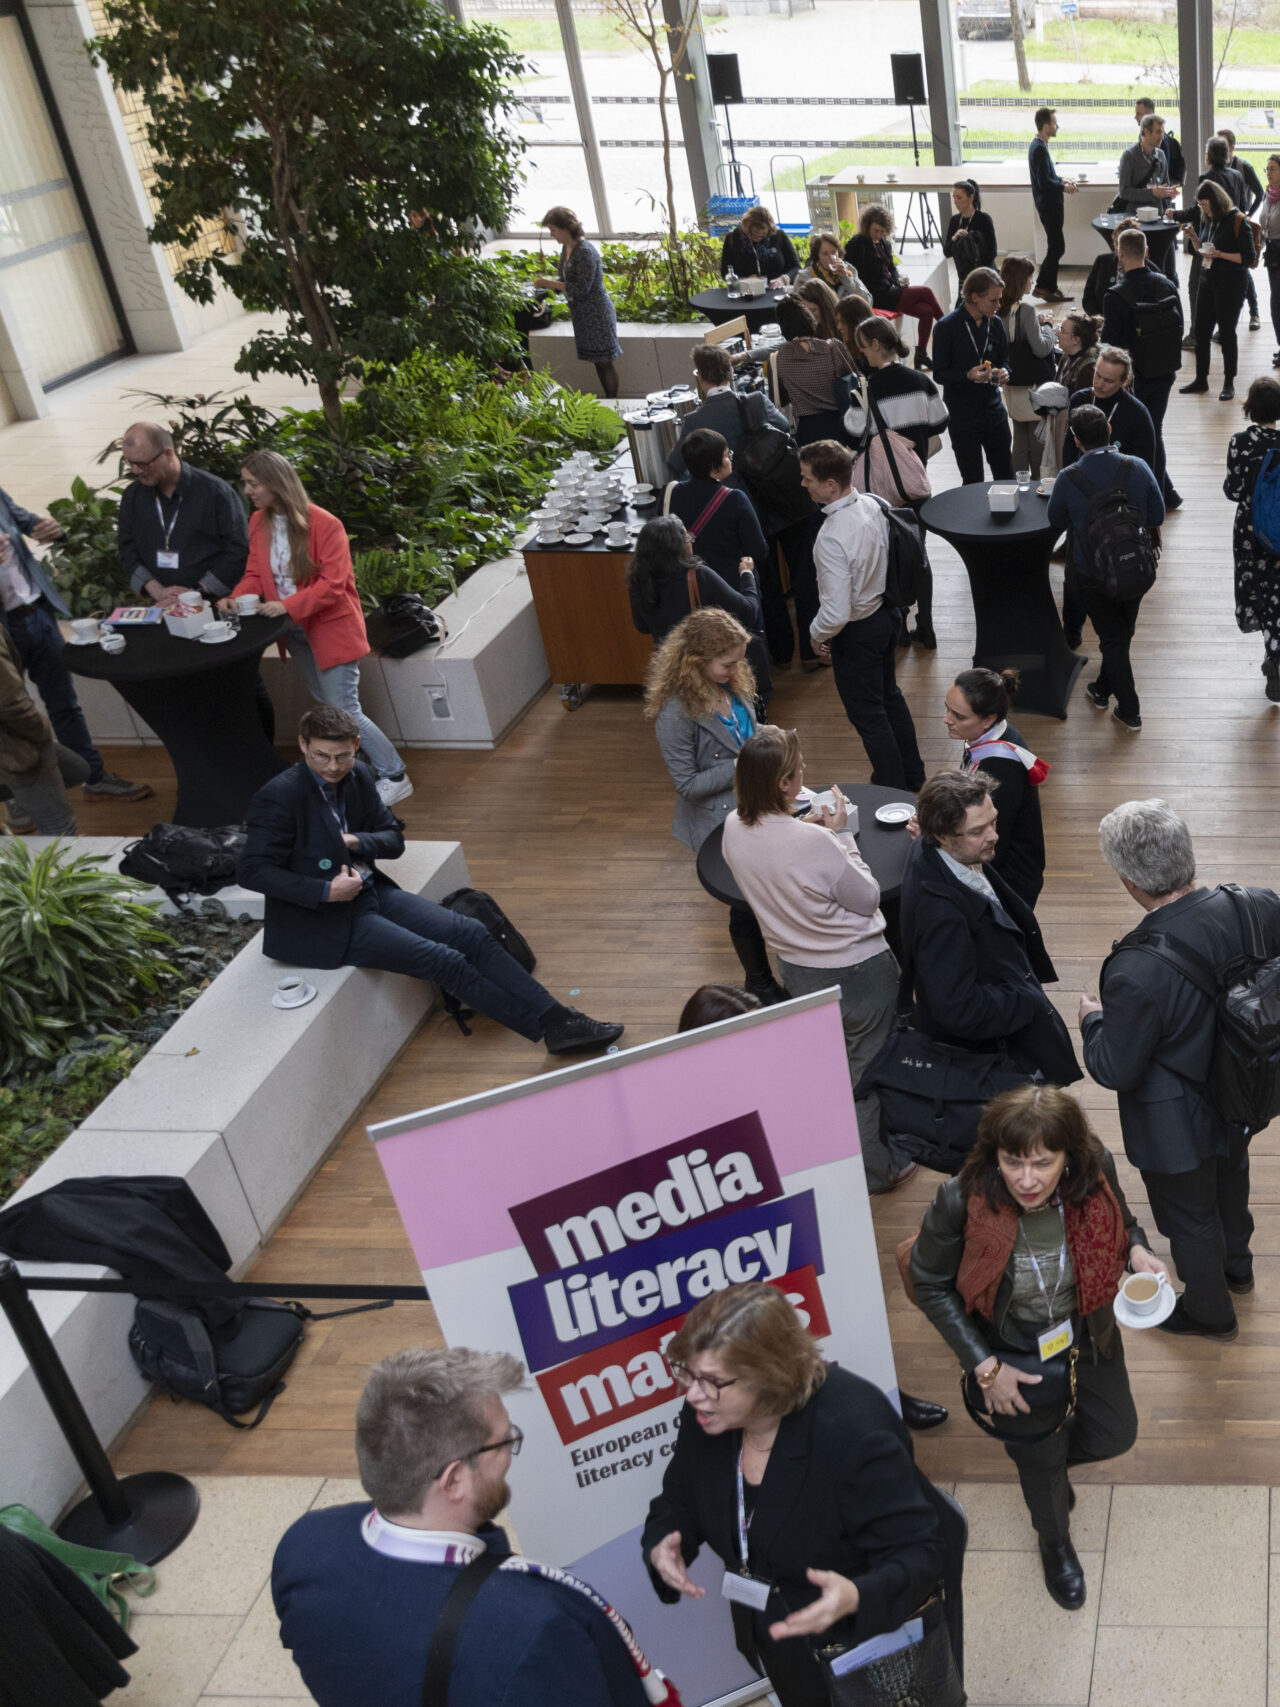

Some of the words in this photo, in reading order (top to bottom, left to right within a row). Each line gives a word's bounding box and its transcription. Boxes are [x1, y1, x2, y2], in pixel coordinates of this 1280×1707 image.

[544, 1149, 764, 1269] media
[544, 1222, 792, 1343] literacy
[570, 1420, 669, 1468] European
[575, 1449, 654, 1488] literacy
